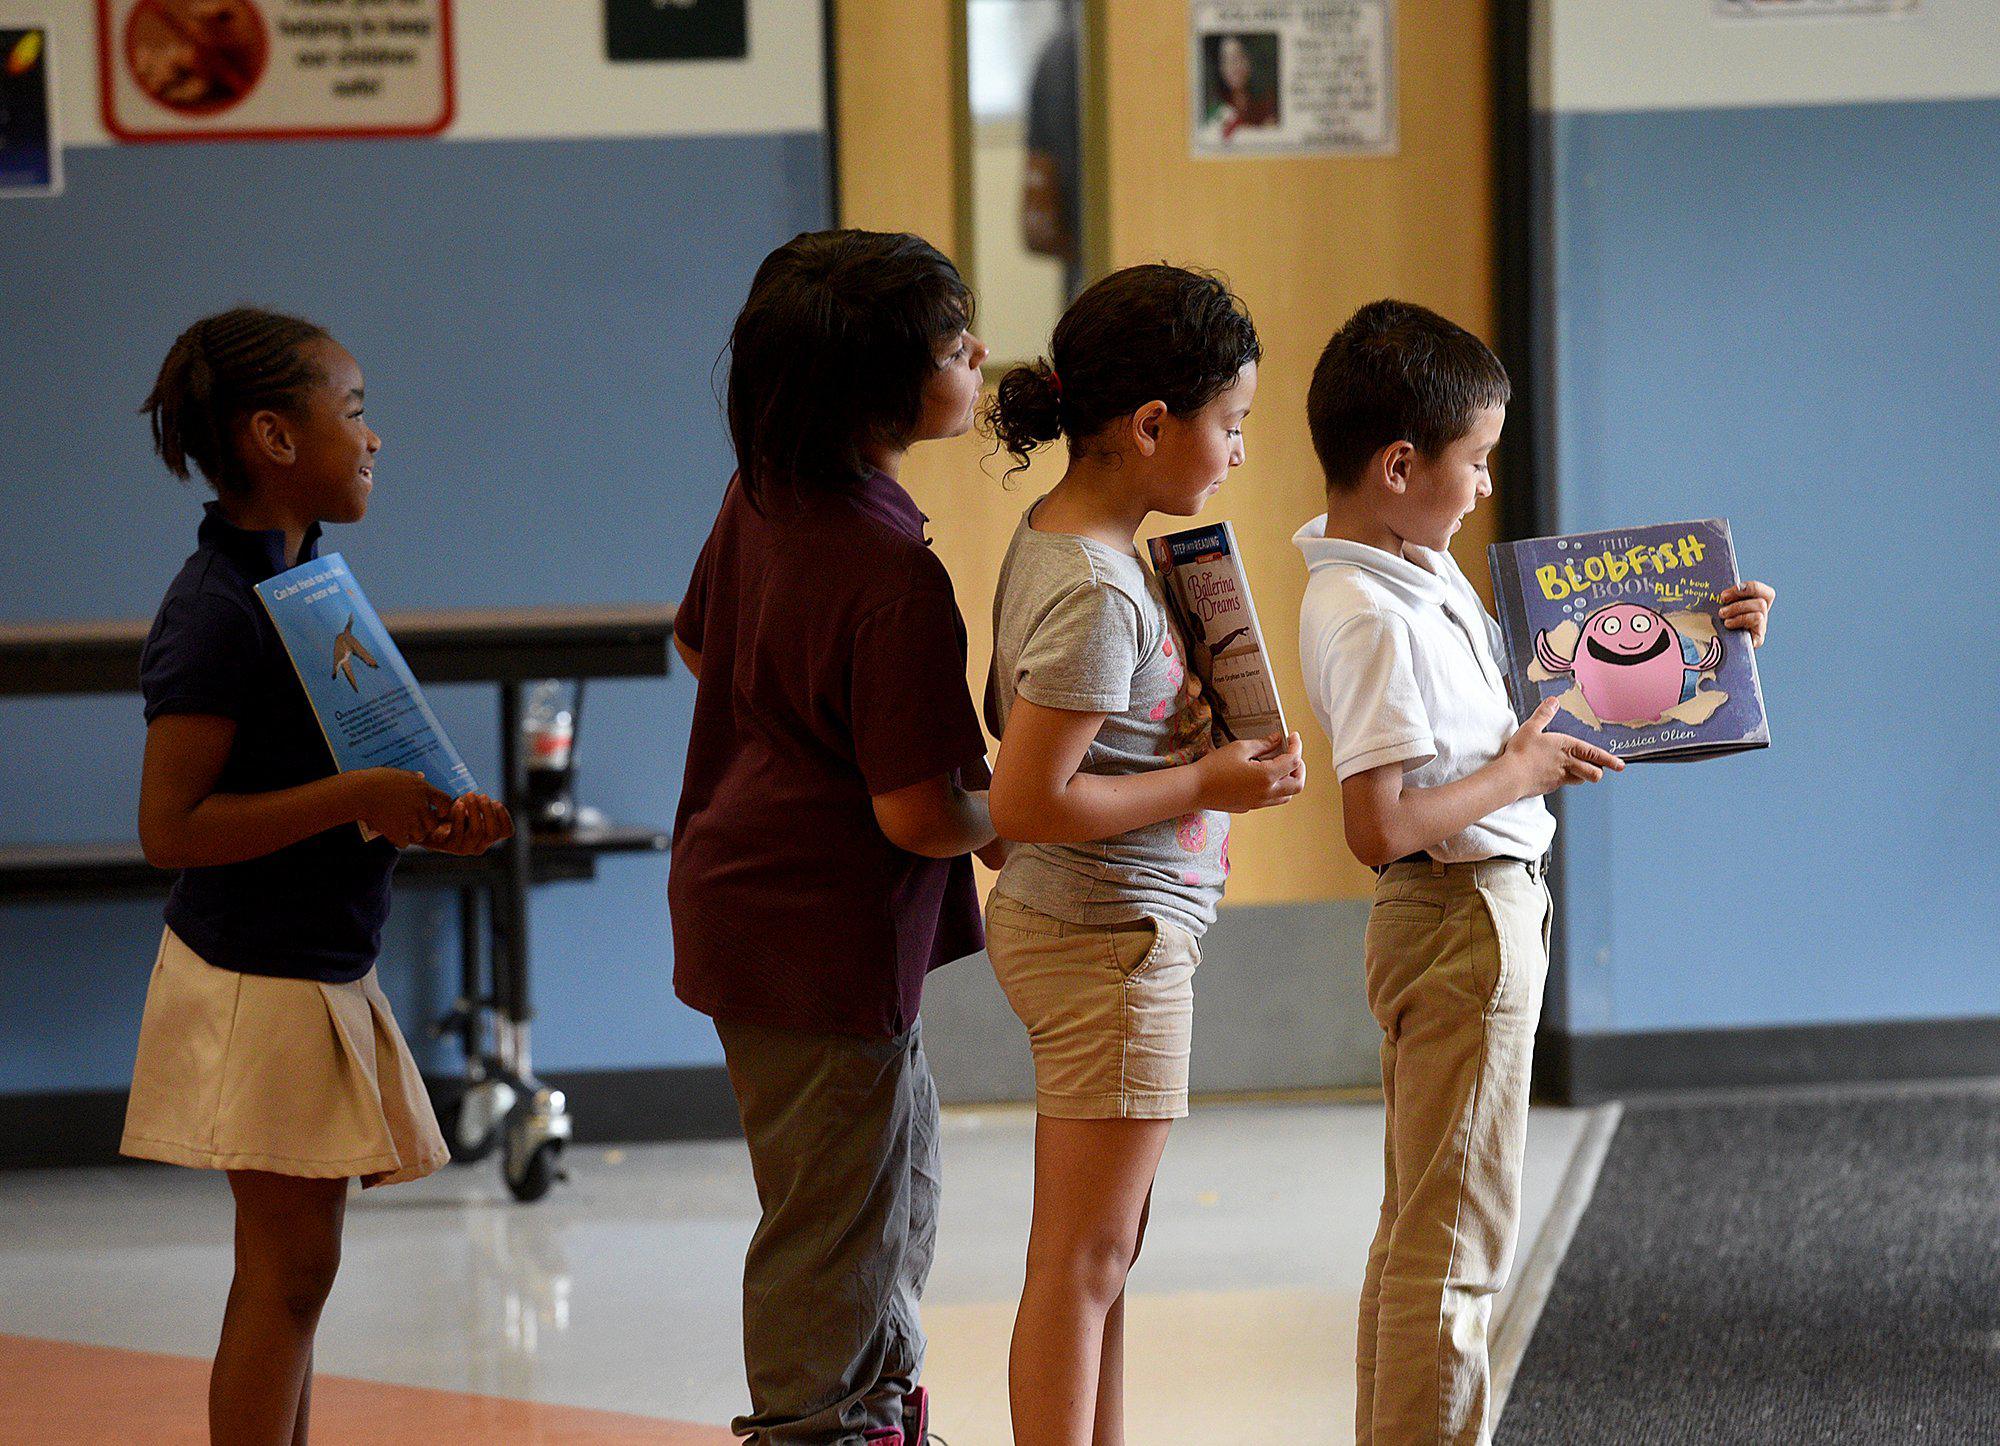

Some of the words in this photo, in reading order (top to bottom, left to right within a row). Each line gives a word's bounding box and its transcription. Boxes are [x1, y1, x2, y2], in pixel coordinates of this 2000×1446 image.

[1173, 543, 1186, 556] STEP
[1194, 535, 1220, 552] READING
[1599, 537, 1635, 551] THE
[1188, 571, 1236, 599] Ballerina
[1654, 581, 1684, 597] ALL
[1684, 588, 1708, 599] about
[1680, 577, 1687, 586] A
[1689, 579, 1710, 589] book
[1197, 597, 1241, 622] Dreams
[1609, 735, 1657, 754] Jessica
[1660, 728, 1696, 742] Olien
